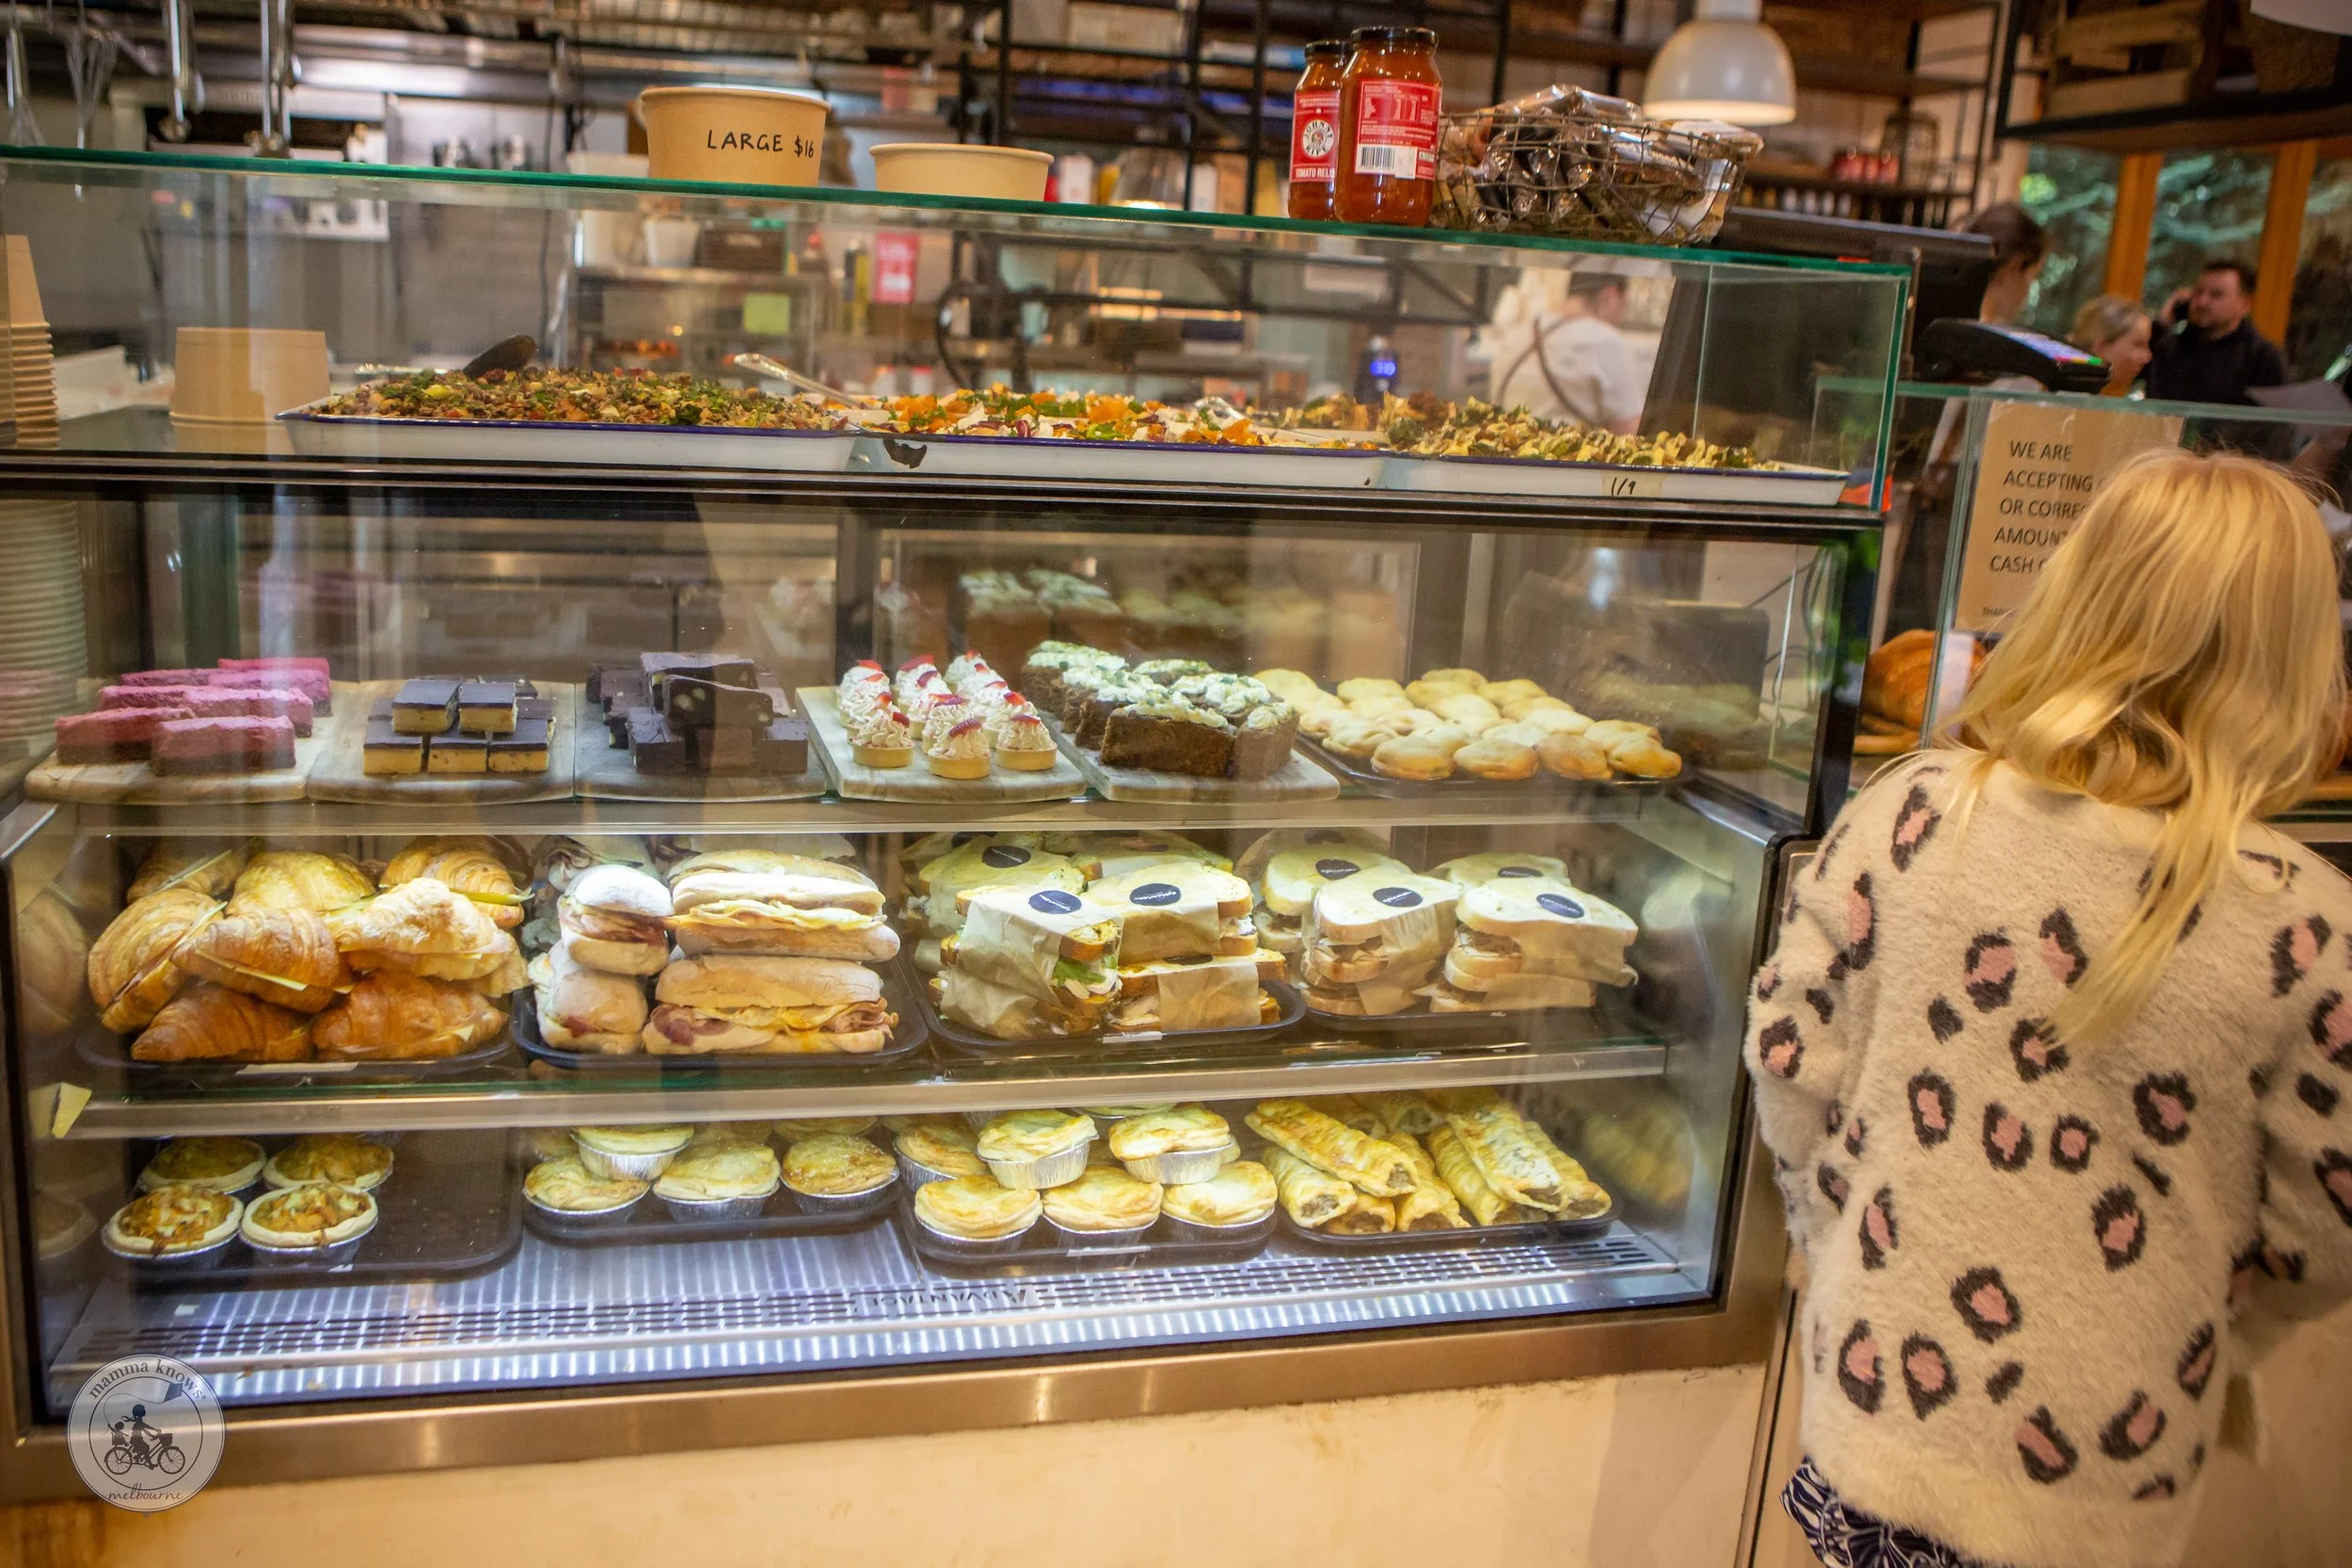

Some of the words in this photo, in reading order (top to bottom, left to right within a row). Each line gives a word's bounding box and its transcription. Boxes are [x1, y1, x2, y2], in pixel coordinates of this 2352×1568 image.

[707, 129, 784, 152] LARGE
[794, 135, 815, 158] $16
[1295, 167, 1316, 179] TOMATO
[2010, 439, 2036, 459] WE
[2039, 442, 2074, 461] ARE
[2003, 469, 2094, 493] ACCEPTING
[1999, 497, 2024, 515] OR
[1990, 555, 2034, 574] CASH
